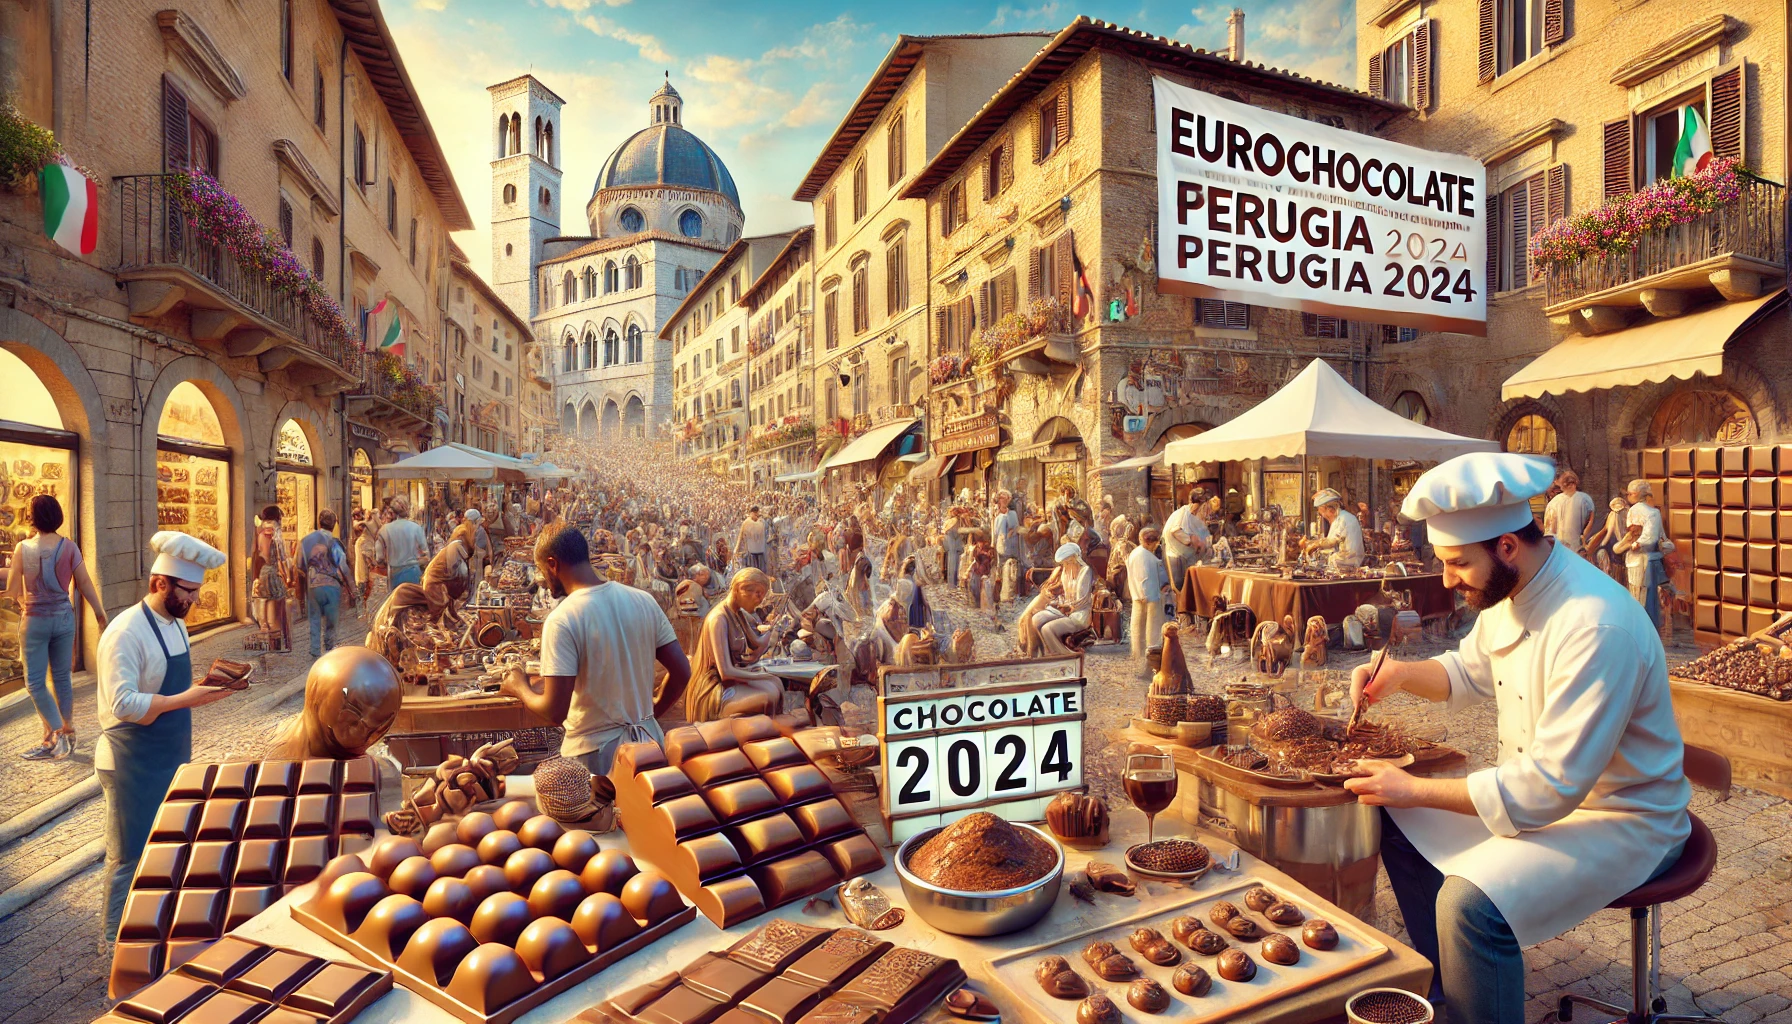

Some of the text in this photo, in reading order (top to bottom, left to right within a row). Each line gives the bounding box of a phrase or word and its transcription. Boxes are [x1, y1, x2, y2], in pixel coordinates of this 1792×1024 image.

[1171, 107, 1474, 217] EUROCHOCOLATE
[1177, 181, 1374, 254] PERUGIA
[1177, 235, 1477, 304] PERUGIA 2024
[893, 692, 1078, 730] CHOCOLATE
[896, 730, 1072, 805] 2024
